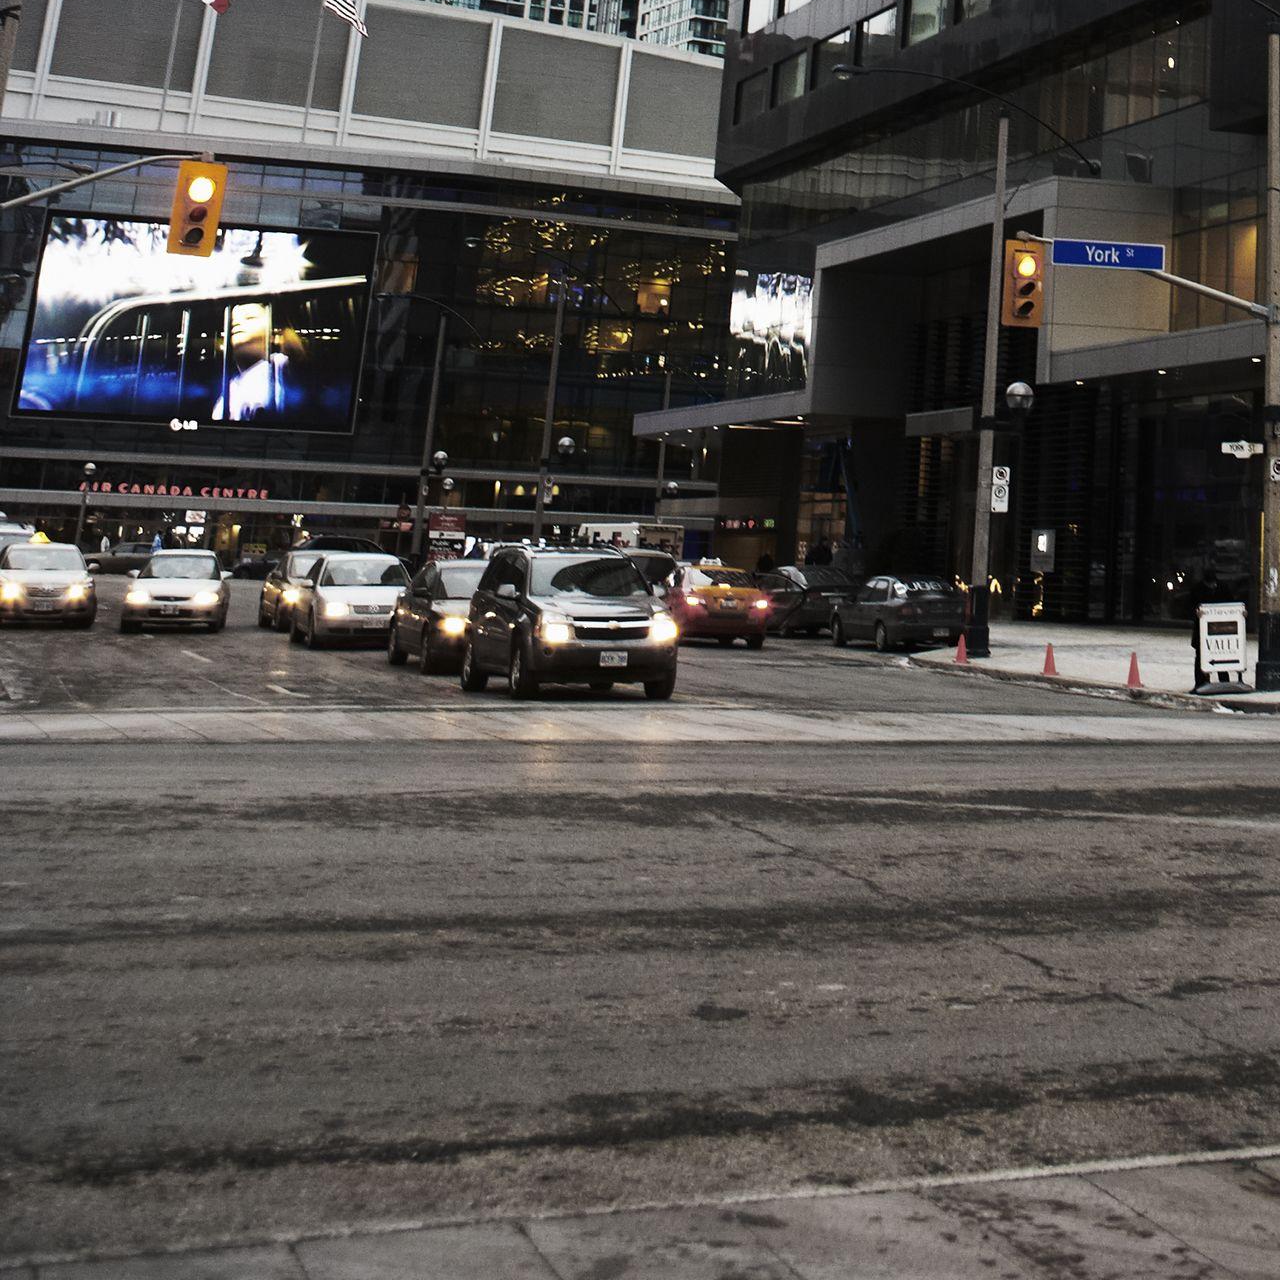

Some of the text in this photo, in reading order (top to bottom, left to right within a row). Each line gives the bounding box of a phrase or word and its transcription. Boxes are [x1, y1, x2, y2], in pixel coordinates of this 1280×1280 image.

[1085, 245, 1135, 264] York St
[79, 481, 269, 500] AIR CANADA CENTRE
